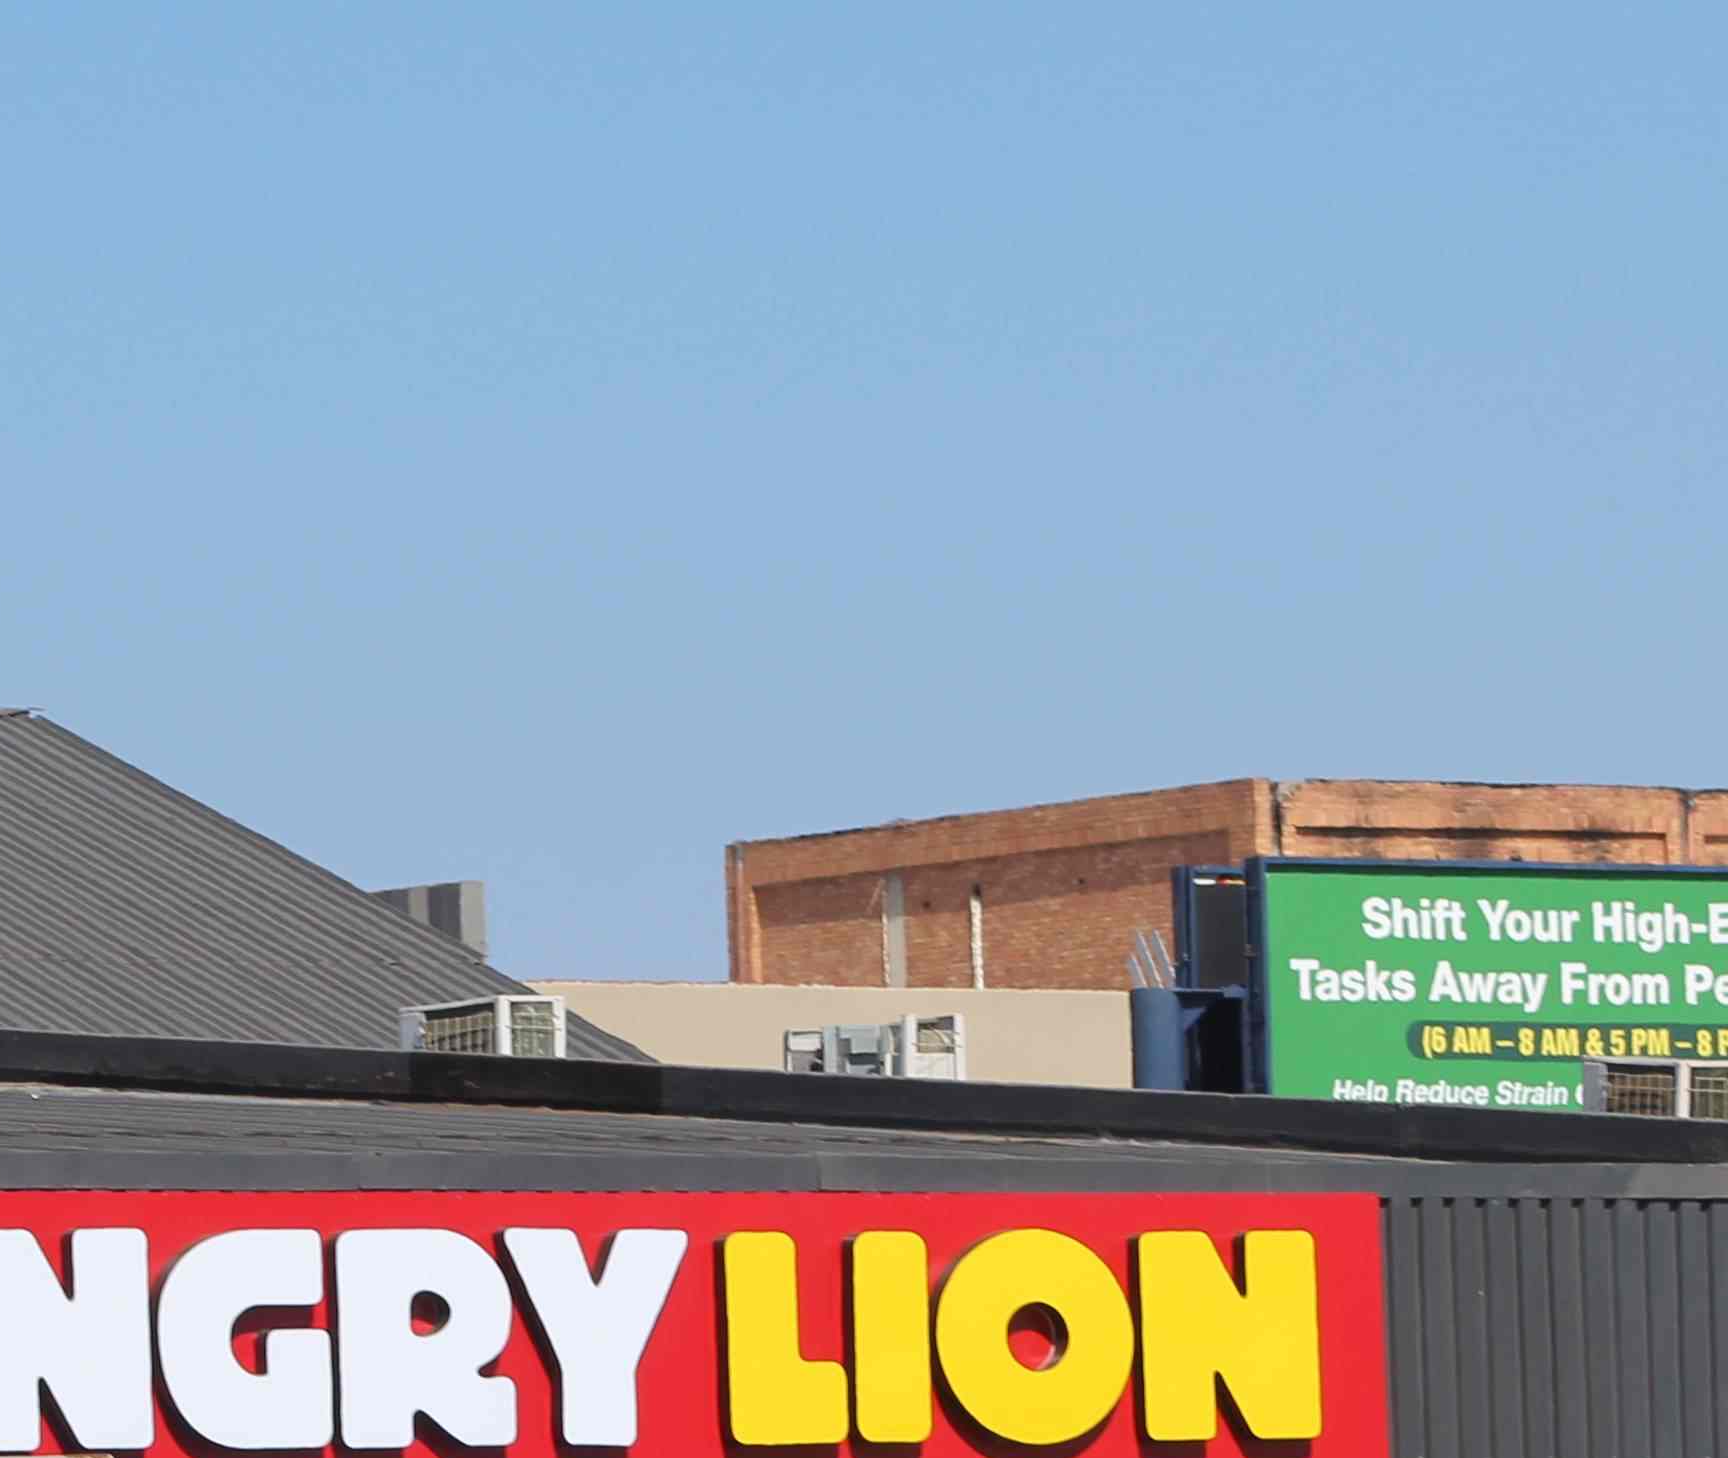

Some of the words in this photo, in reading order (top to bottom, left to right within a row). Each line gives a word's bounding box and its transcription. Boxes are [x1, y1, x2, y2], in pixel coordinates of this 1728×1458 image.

[1361, 896, 1467, 941] Shift
[1476, 898, 1580, 943] Your
[1289, 957, 1417, 1003] Tasks
[1428, 959, 1549, 1013] Away
[1560, 961, 1671, 1006] From
[1422, 1025, 1448, 1058] (6
[1453, 1026, 1493, 1056] AM
[1518, 1028, 1535, 1057] 8
[1541, 1028, 1581, 1057] AM
[1585, 1029, 1606, 1057] &
[1609, 1029, 1626, 1057] 5
[1631, 1029, 1672, 1058] PM
[1696, 1030, 1712, 1058] 8
[1332, 1079, 1389, 1103] Help
[1394, 1078, 1490, 1105] Reduce
[1494, 1080, 1570, 1105] Strain
[723, 1228, 1323, 1446] LION
